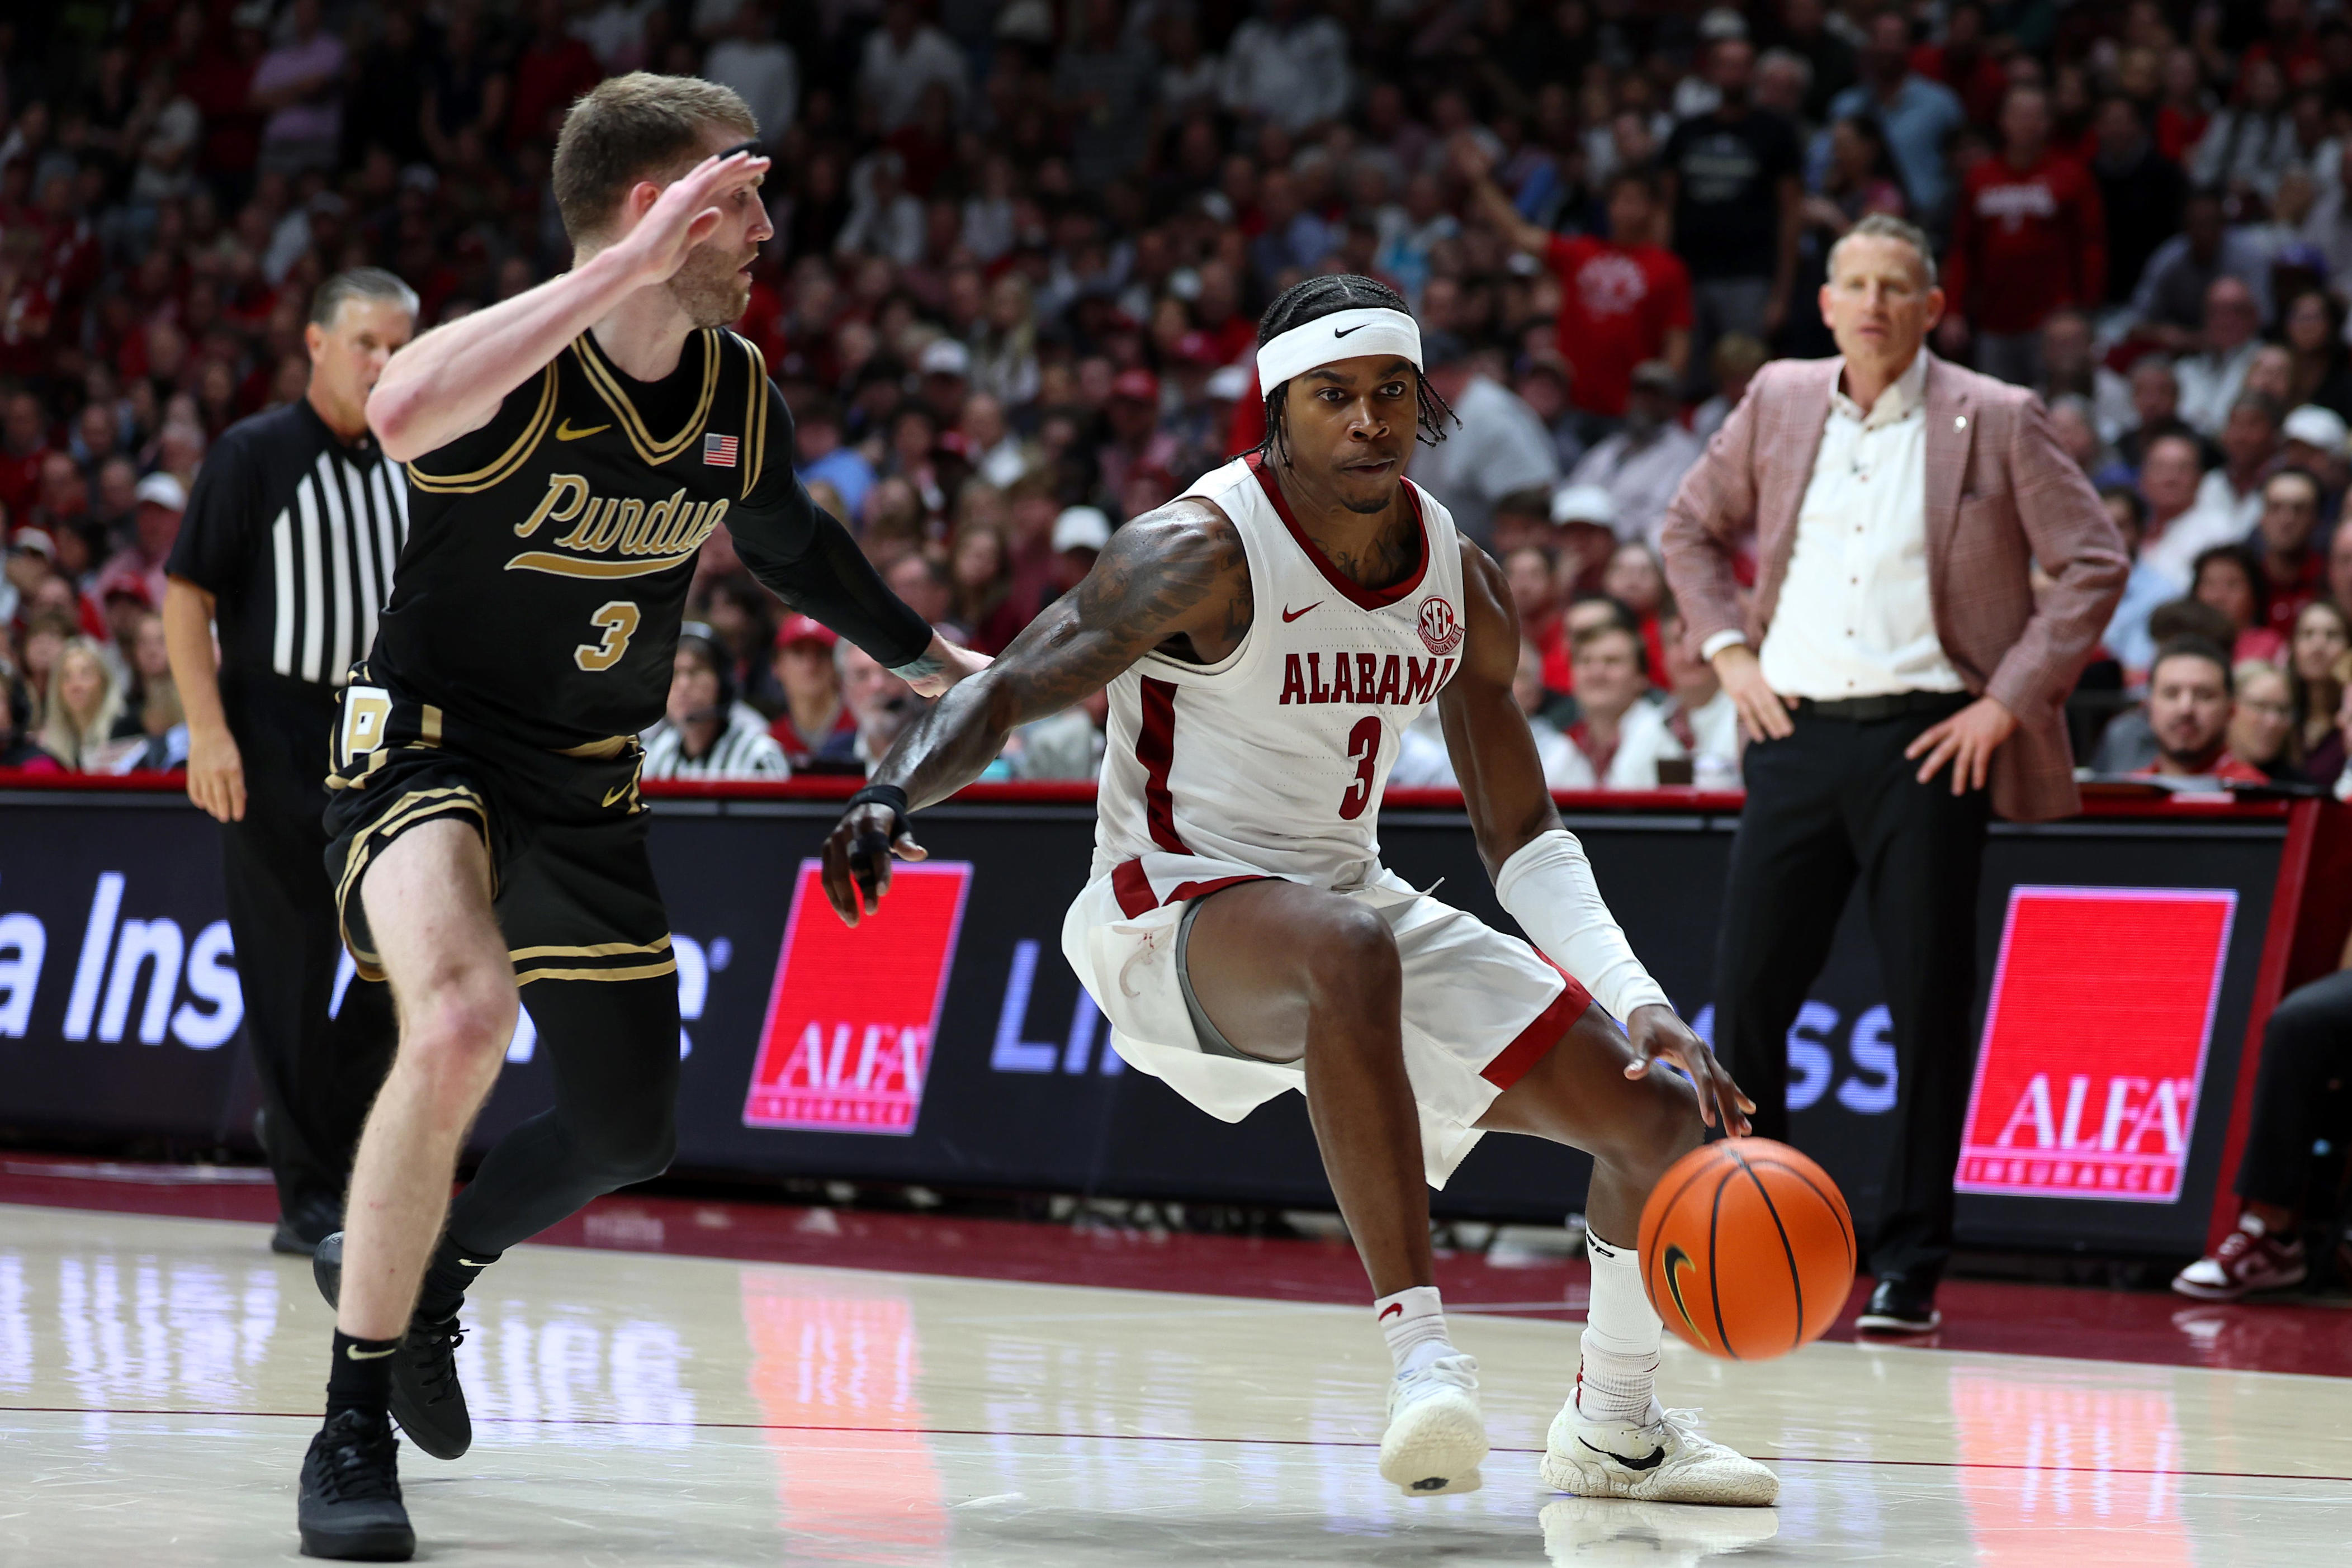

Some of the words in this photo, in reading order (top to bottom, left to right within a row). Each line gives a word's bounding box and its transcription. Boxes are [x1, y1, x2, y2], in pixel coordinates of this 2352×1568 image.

[514, 473, 730, 555] Purdue
[573, 600, 641, 671] 3
[1421, 600, 1452, 640] SEC
[1423, 635, 1458, 653] GRADUATE
[1338, 716, 1381, 821] 3
[777, 1021, 922, 1093] ALFA
[1995, 1073, 2183, 1154] ALFA
